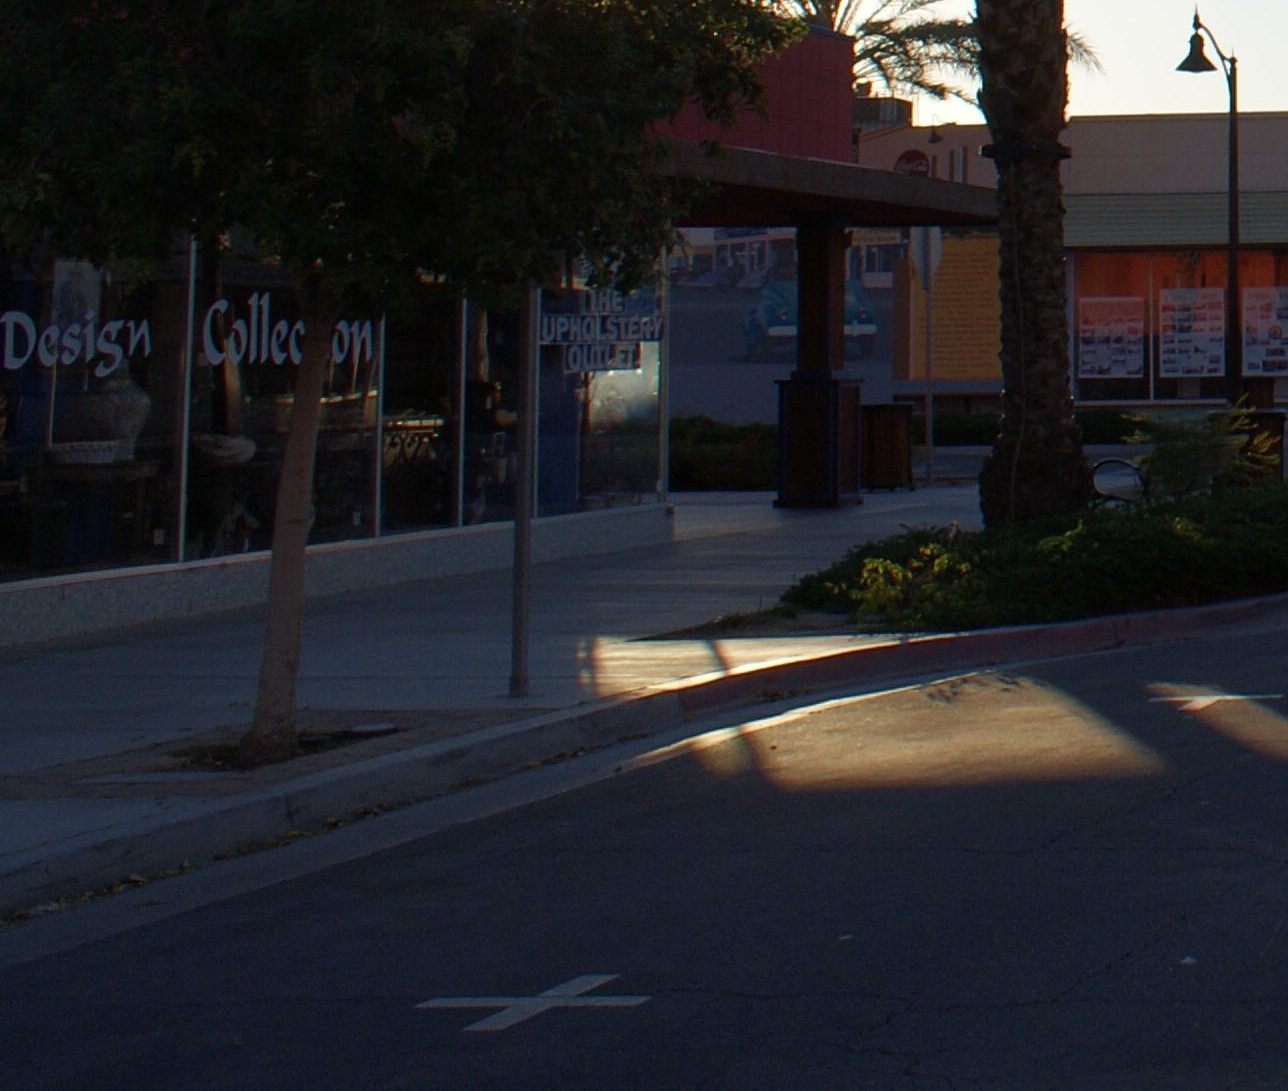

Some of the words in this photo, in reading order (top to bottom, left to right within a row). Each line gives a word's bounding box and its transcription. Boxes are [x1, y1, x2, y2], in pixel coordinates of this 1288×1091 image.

[583, 288, 625, 313] THE
[0, 309, 151, 378] Design
[203, 291, 374, 365] Collecon
[541, 315, 662, 342] UPHOLSTERY
[567, 343, 638, 368] OUTLET
